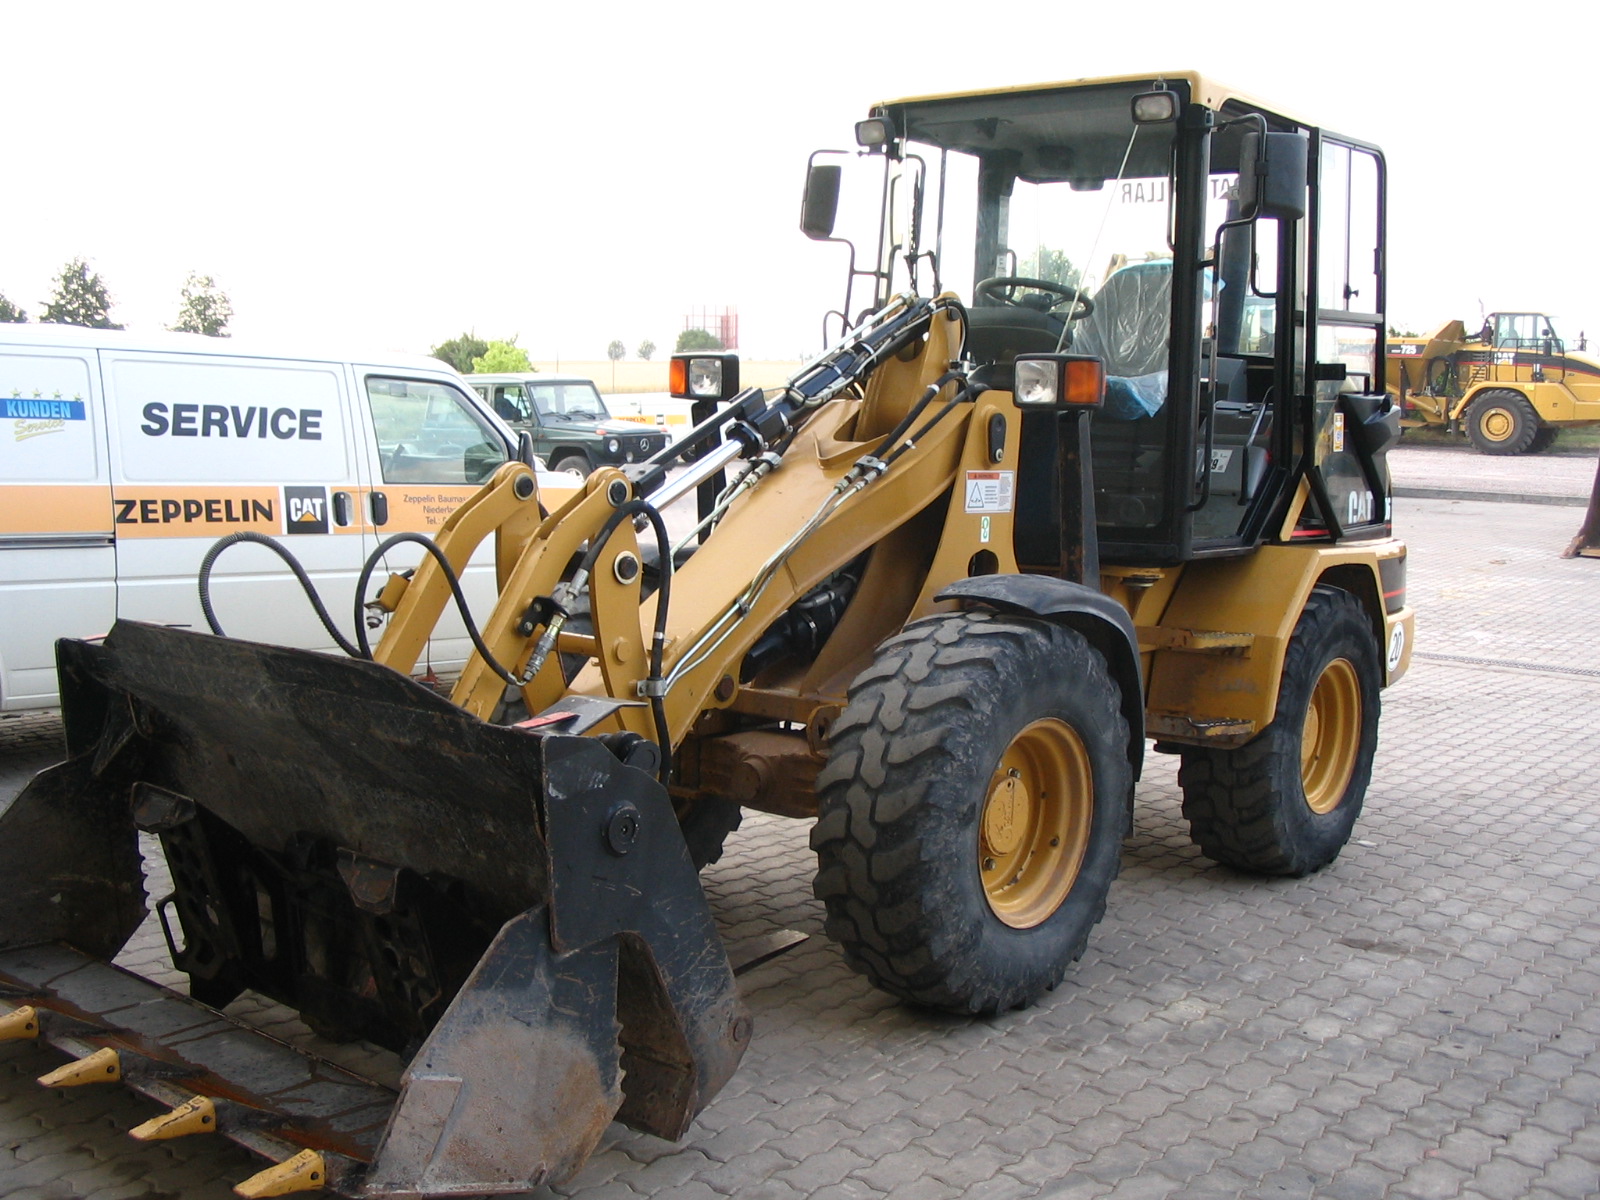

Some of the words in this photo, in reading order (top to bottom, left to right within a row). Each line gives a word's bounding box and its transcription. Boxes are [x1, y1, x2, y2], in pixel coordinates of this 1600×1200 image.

[1400, 344, 1417, 355] 725
[6, 400, 72, 418] KUNDEN
[140, 401, 323, 441] SERVICE
[14, 418, 66, 435] Service
[289, 497, 323, 522] CAT
[403, 494, 435, 503] Zeppelin
[1347, 490, 1374, 524] CAT
[115, 499, 274, 523] ZEPPELIN
[1389, 630, 1402, 663] 20
